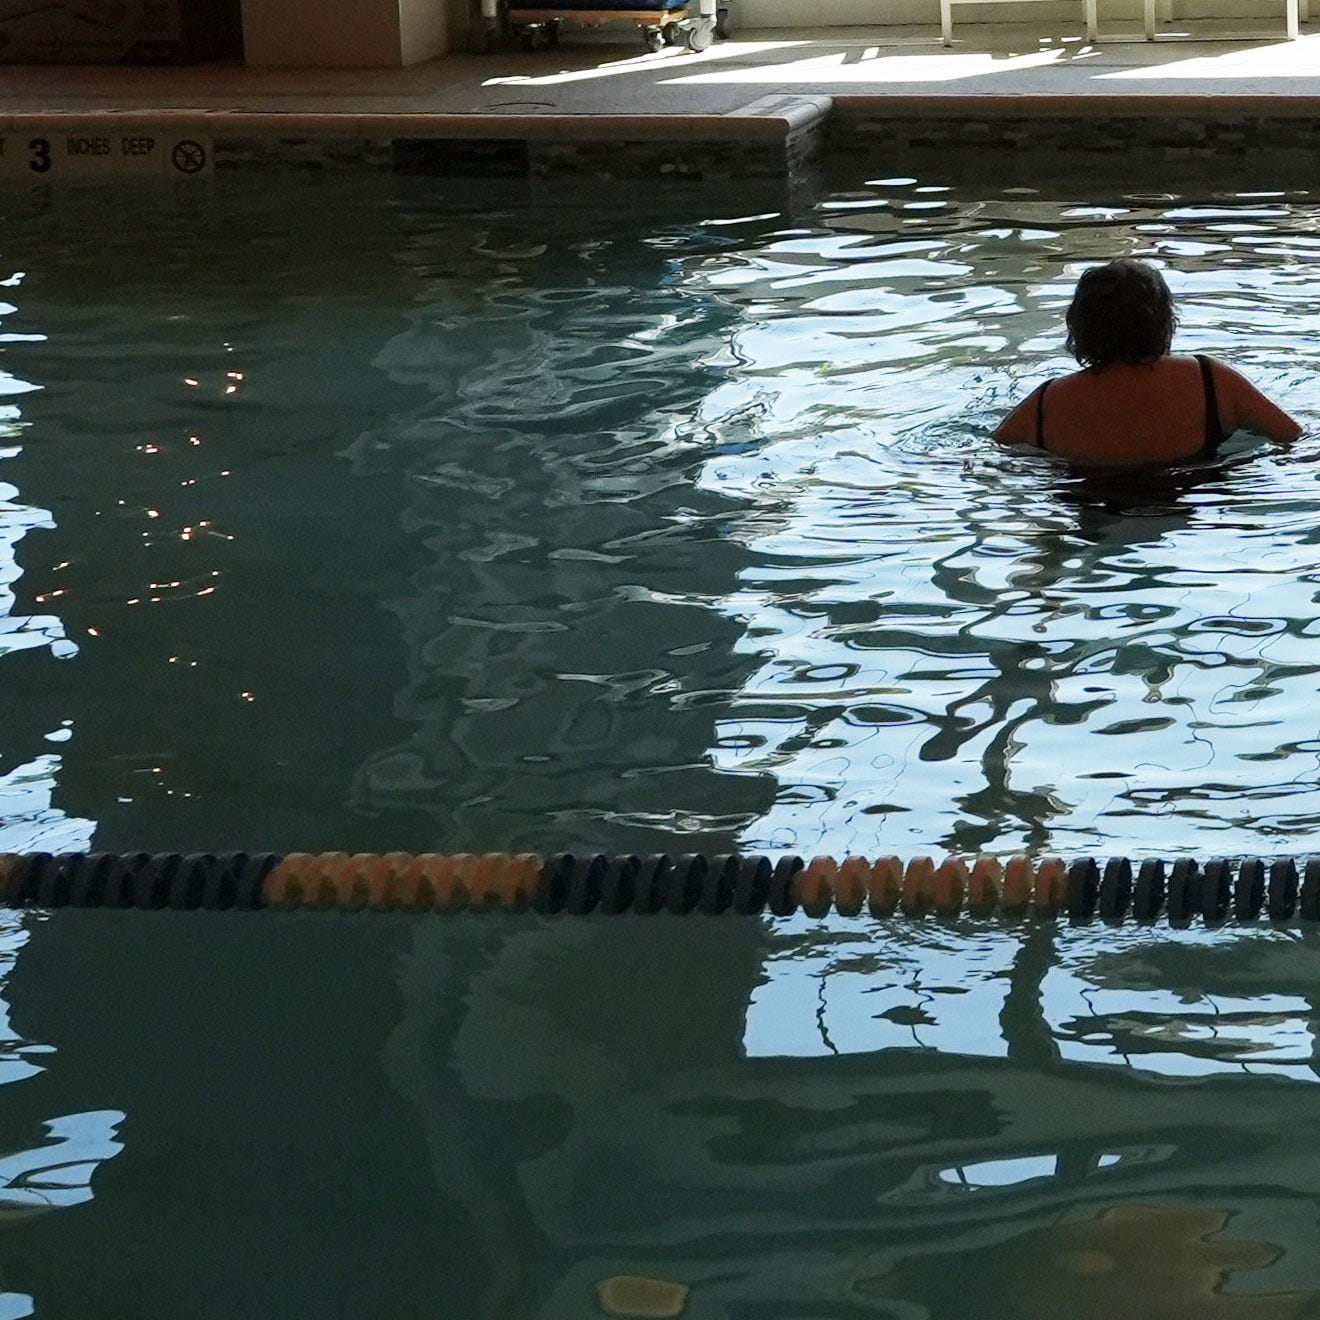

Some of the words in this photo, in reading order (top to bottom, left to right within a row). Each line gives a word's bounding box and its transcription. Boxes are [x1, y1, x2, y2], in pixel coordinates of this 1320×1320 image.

[28, 137, 51, 173] 3
[66, 137, 110, 156] INCHES
[121, 136, 154, 156] DEEP
